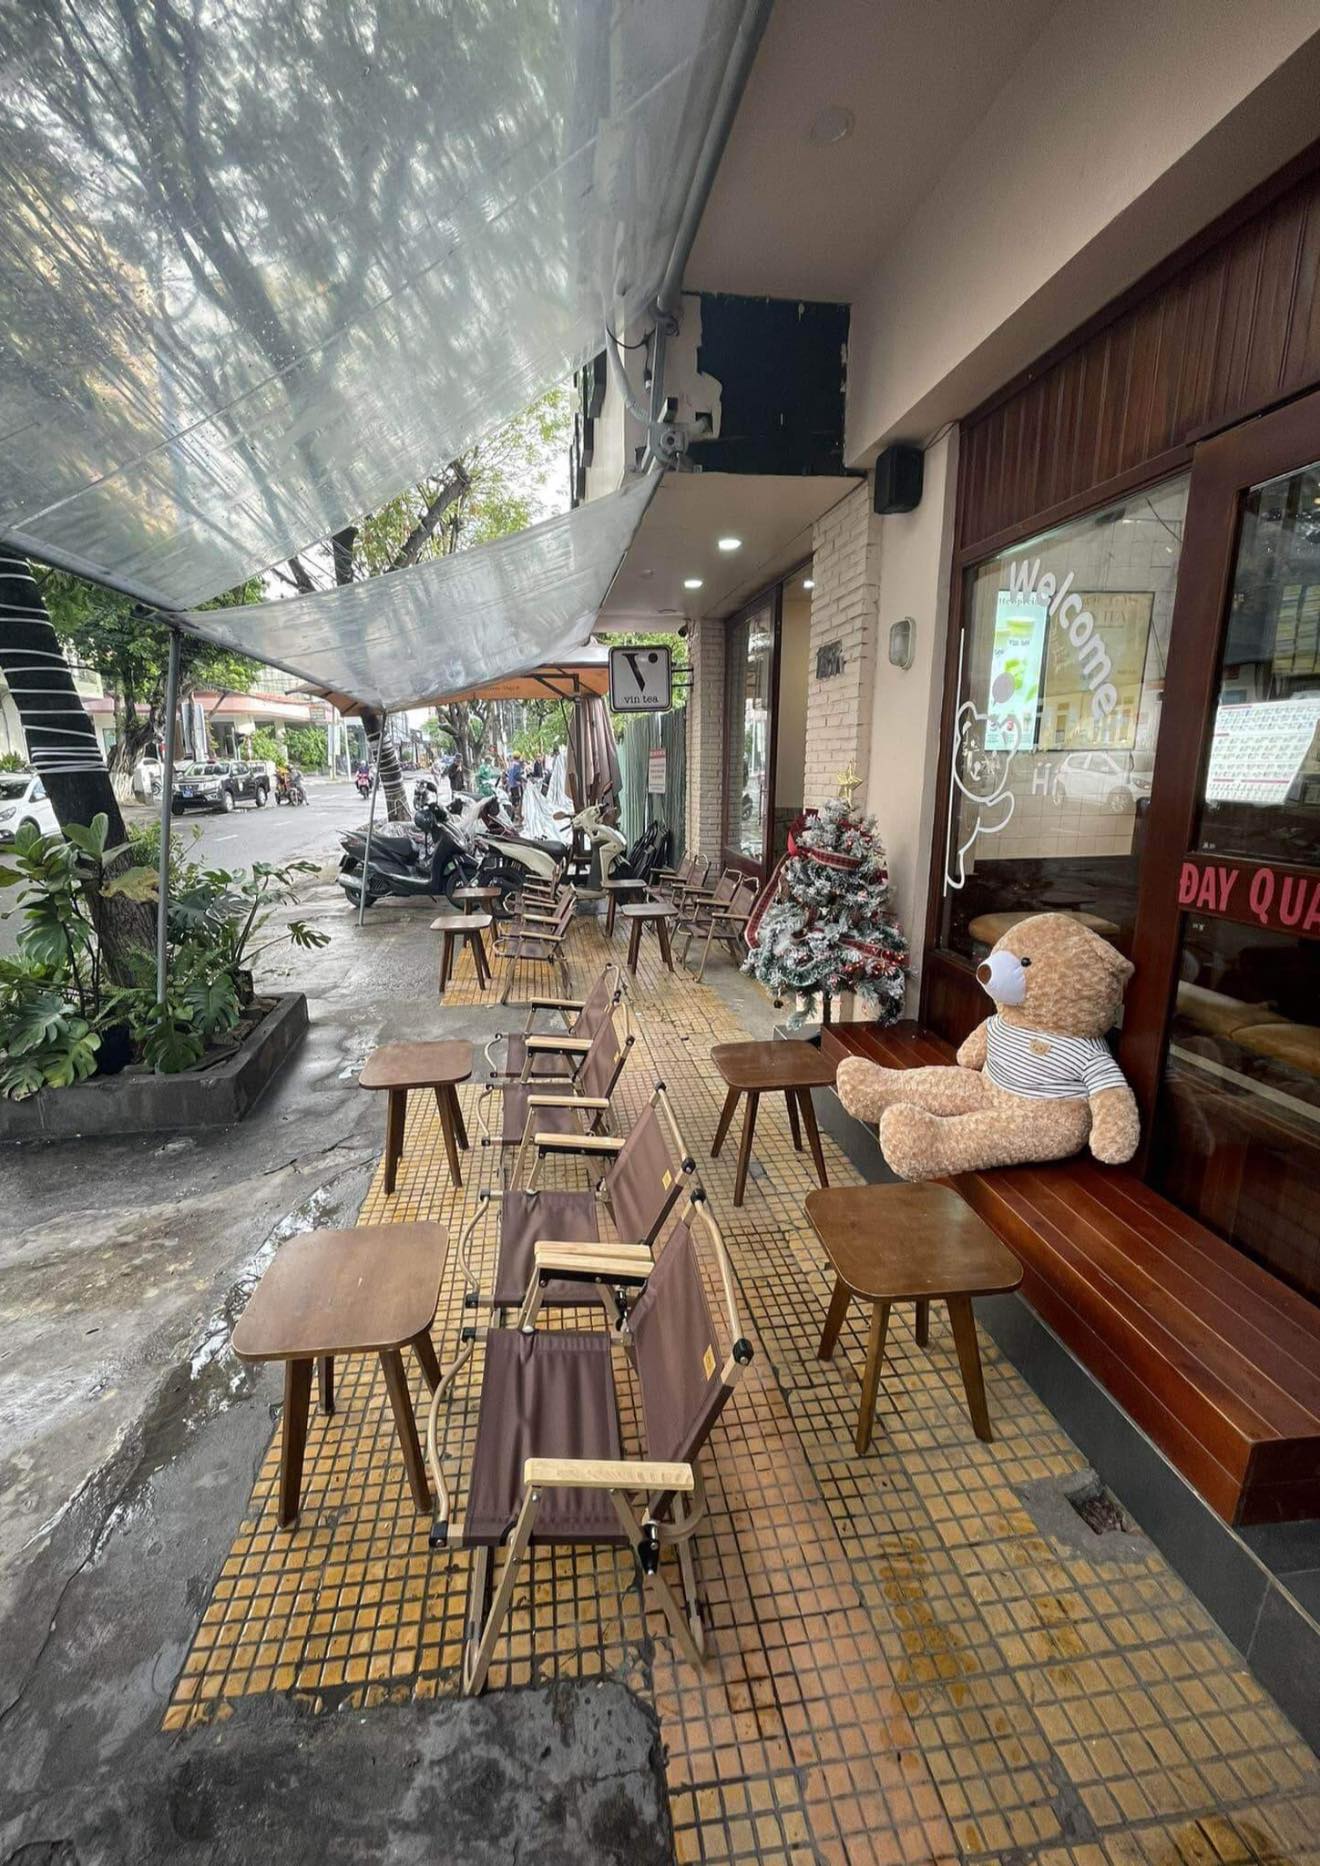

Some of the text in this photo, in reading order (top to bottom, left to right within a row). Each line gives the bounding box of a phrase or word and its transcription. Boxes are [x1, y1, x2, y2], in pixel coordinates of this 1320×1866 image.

[1008, 557, 1118, 717] Welcome
[624, 694, 659, 704] vin tea
[1178, 862, 1240, 913] ĐAY
